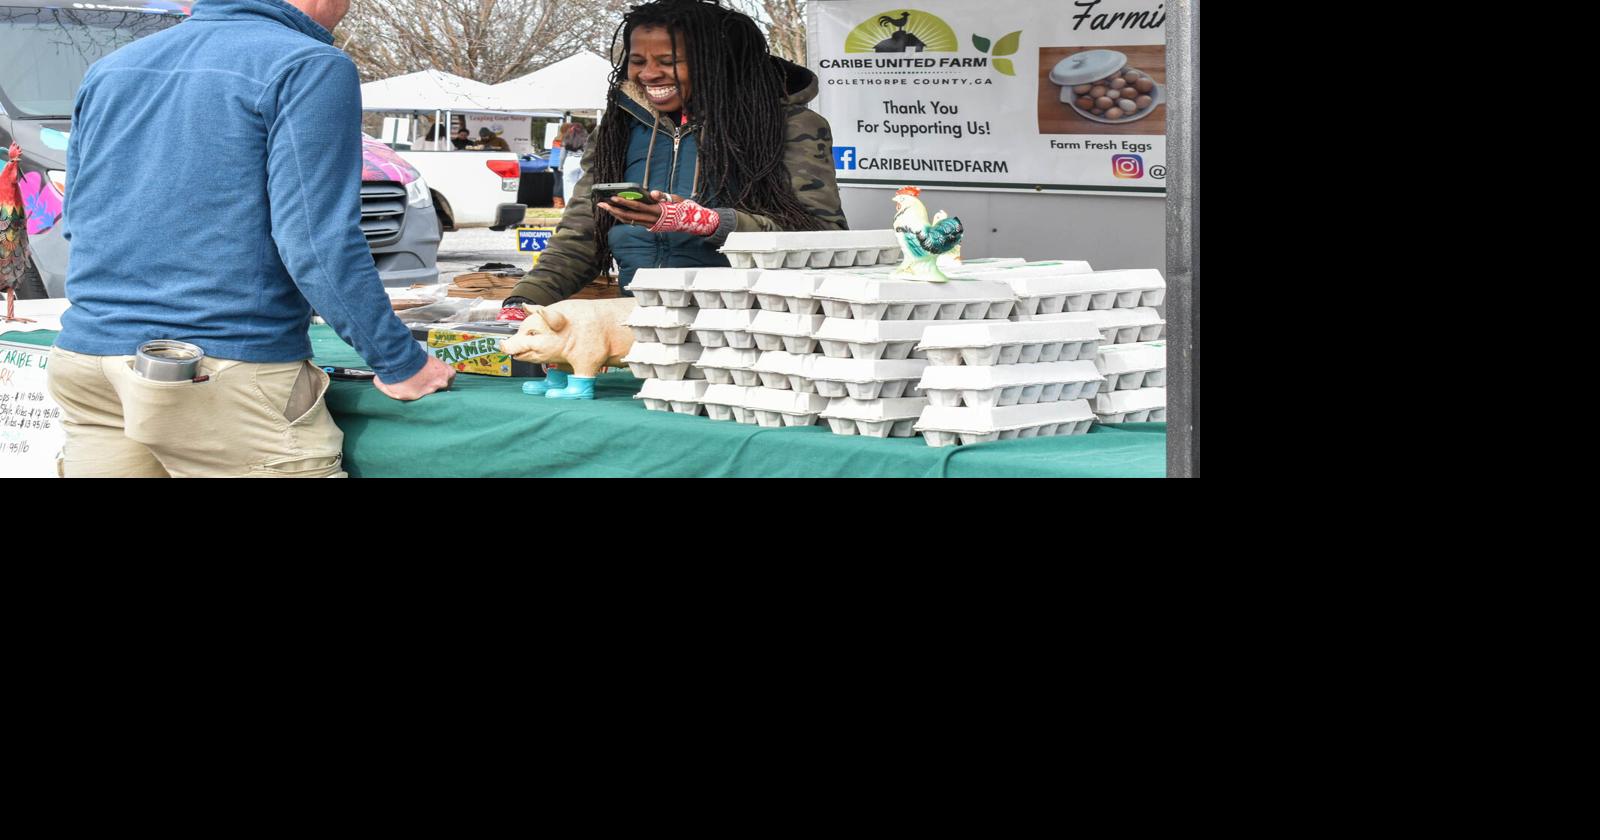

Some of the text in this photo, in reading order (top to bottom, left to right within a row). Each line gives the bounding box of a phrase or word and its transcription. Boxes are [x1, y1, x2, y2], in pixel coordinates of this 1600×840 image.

[819, 57, 988, 69] CARIBE UNITED FARM
[883, 99, 958, 115] Thank You
[857, 119, 991, 139] For Supporting Us!
[1050, 139, 1152, 153] Farm Fresh Eggs
[858, 157, 1009, 173] CARIBEUNITEDFARM
[519, 231, 552, 239] HANDICAPPED
[435, 337, 501, 362] FARMER
